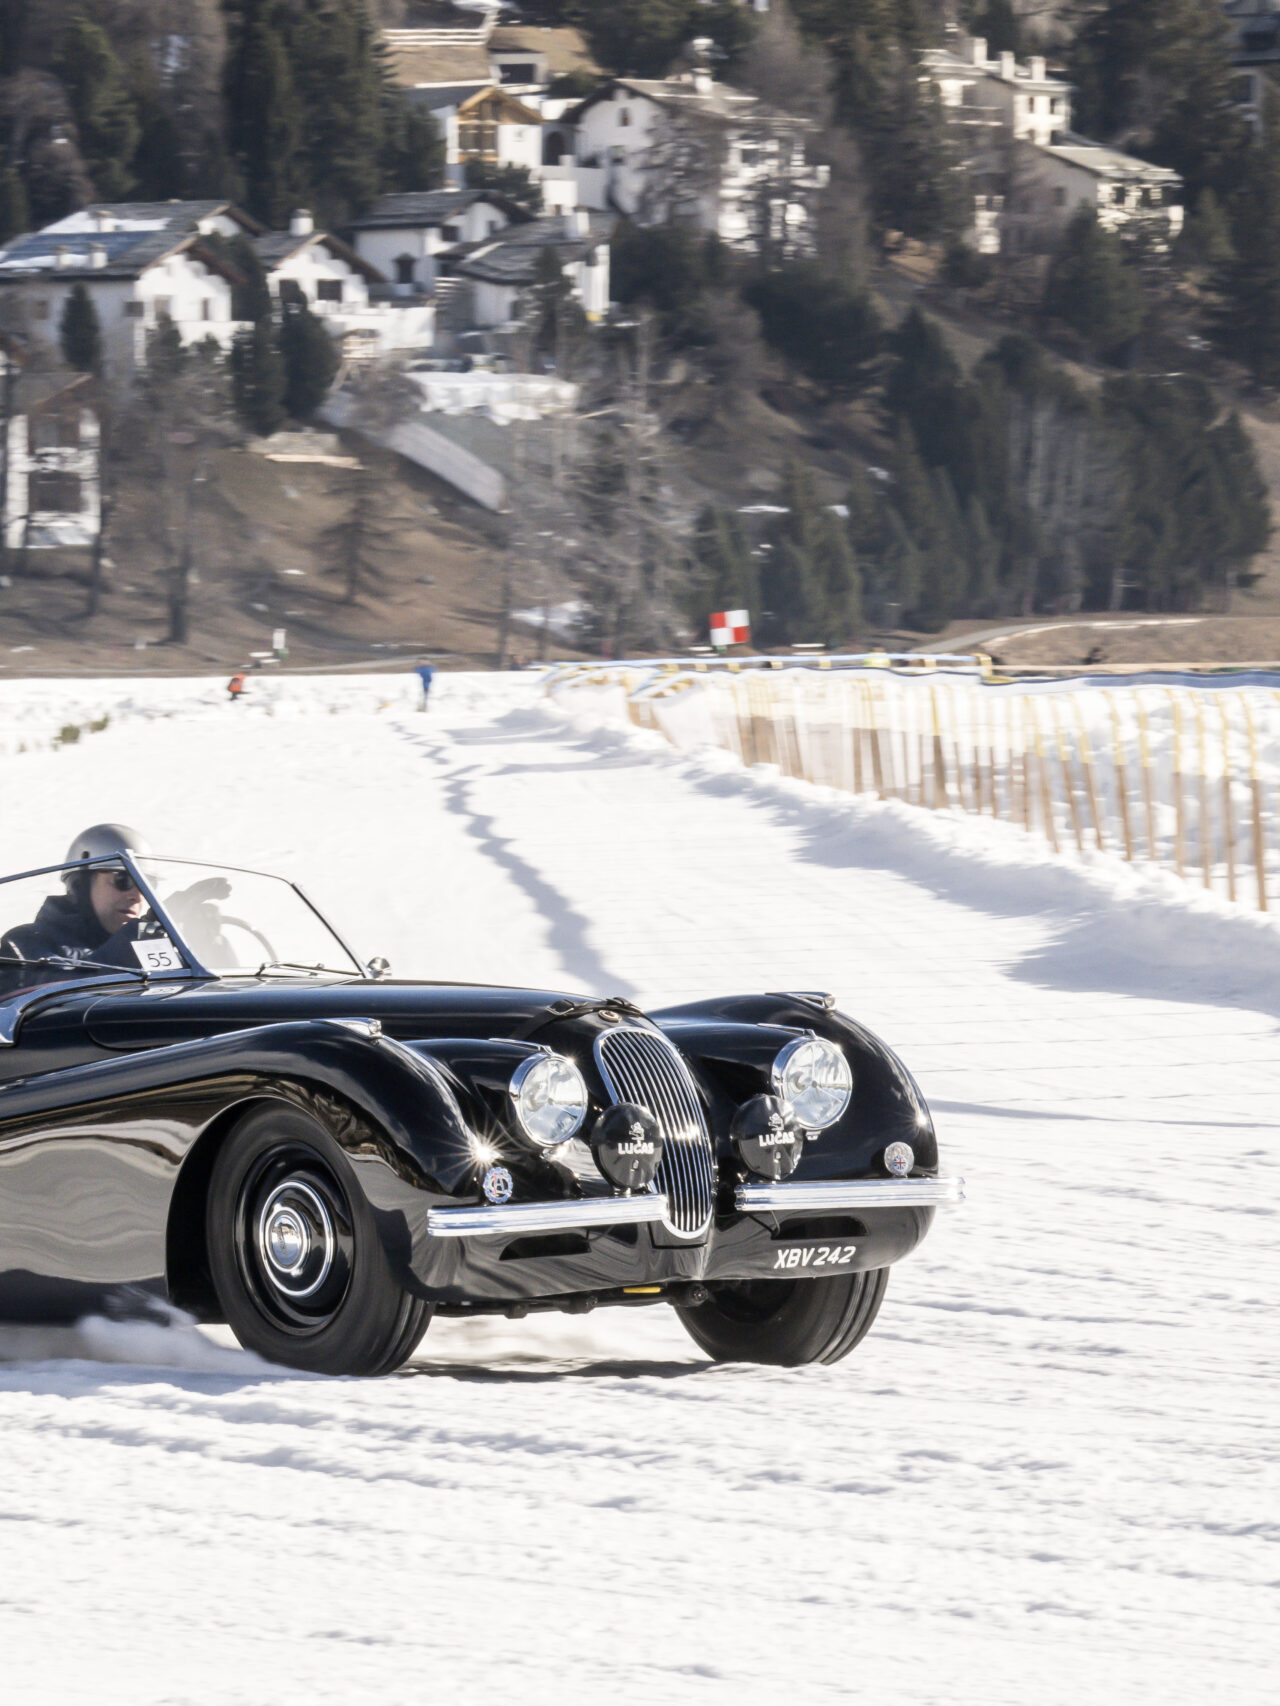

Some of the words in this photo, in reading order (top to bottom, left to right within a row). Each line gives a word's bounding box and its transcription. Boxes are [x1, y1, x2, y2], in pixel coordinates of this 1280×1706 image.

[147, 952, 172, 968] 55
[758, 1131, 796, 1147] LUCAS
[617, 1142, 655, 1155] LUCAS
[773, 1247, 816, 1270] XBV
[812, 1245, 857, 1266] 242
